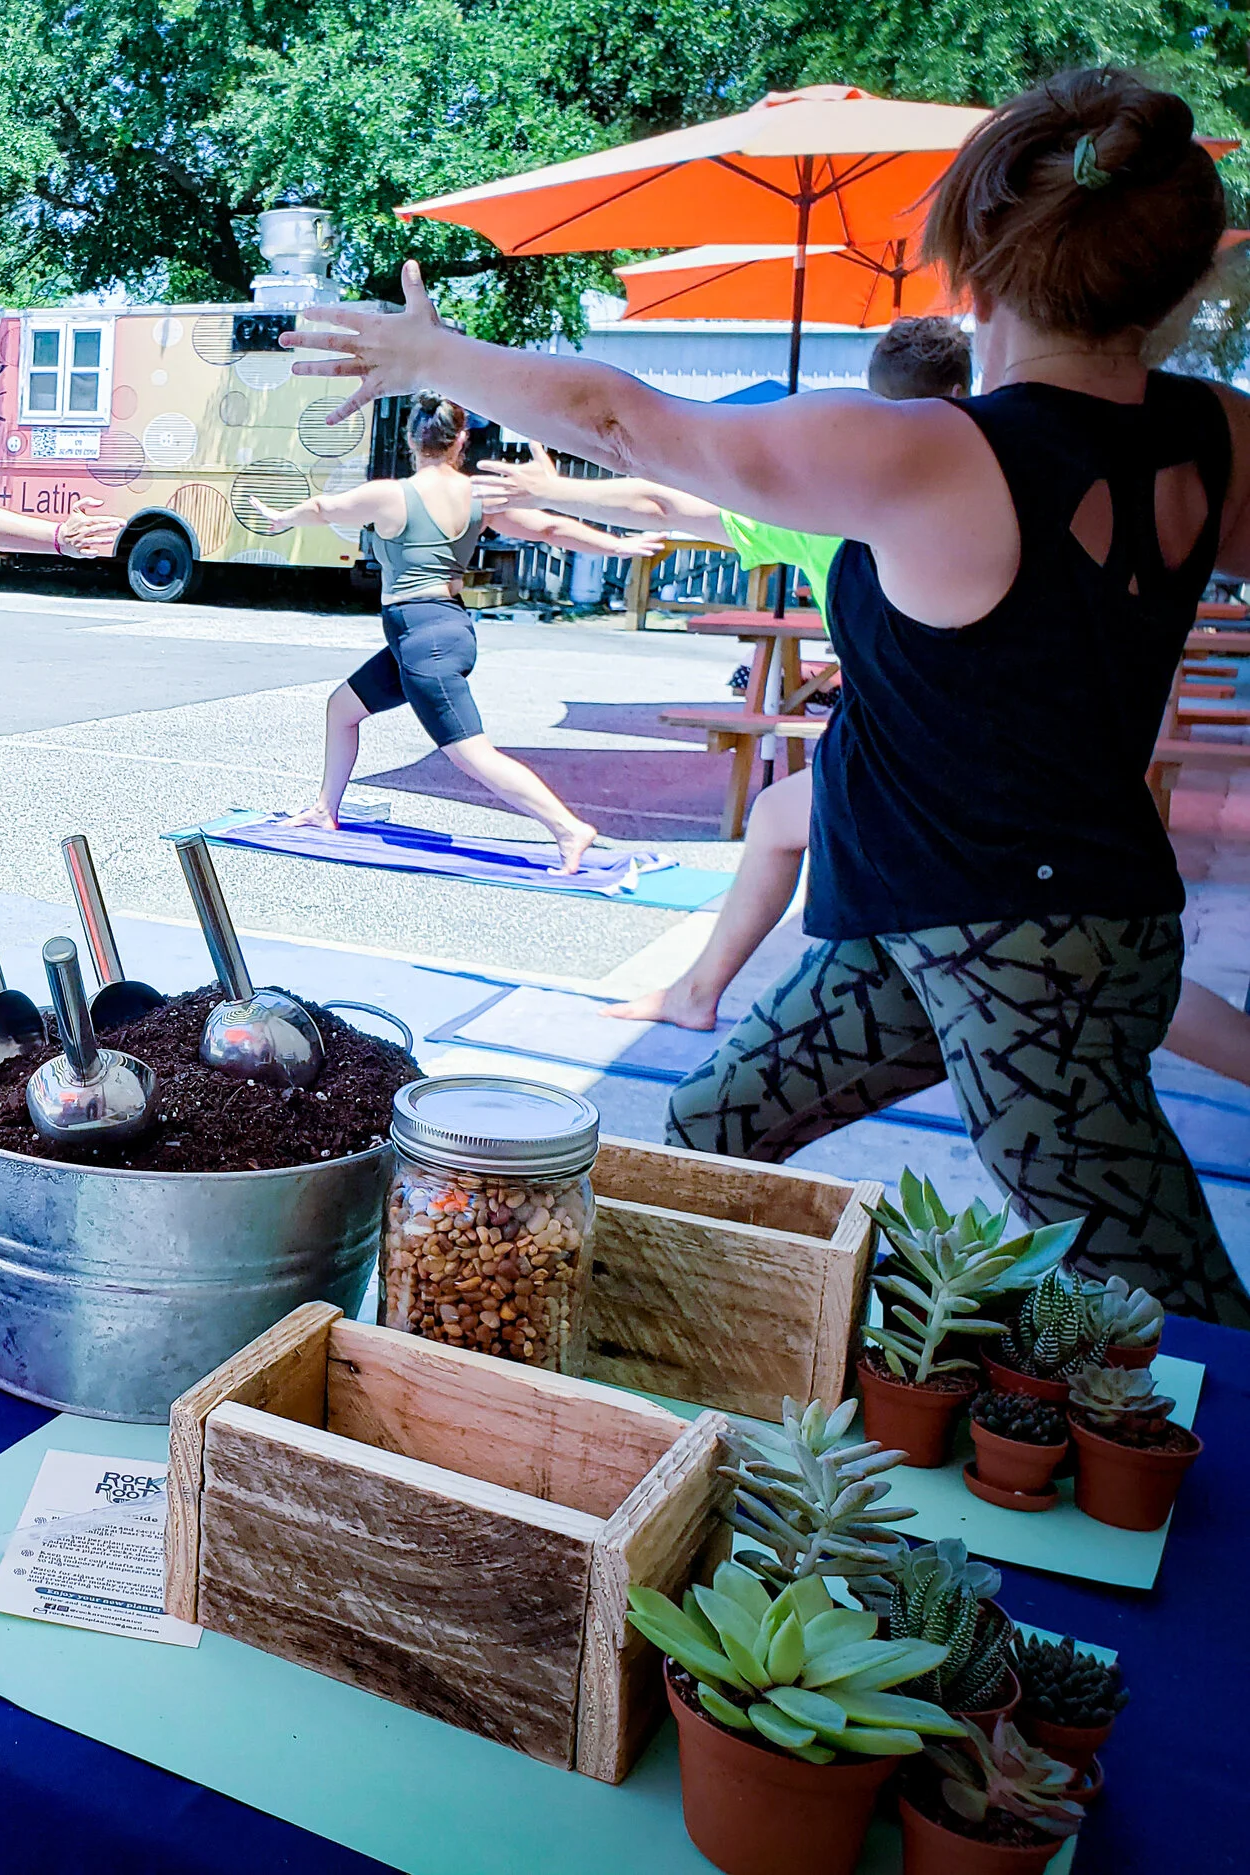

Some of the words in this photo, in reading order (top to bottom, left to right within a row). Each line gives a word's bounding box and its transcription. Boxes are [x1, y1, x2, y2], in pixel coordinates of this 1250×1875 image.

[21, 481, 81, 515] Latin
[95, 1483, 161, 1502] ROOT
[49, 1539, 91, 1549] nderneath
[123, 1554, 156, 1563] dropper
[105, 1565, 161, 1578] temperatures
[28, 1573, 91, 1588] underwatering
[93, 1584, 121, 1592] where
[122, 1589, 148, 1597] leaves
[88, 1579, 117, 1588] mushy
[130, 1586, 158, 1595] yellow
[106, 1578, 163, 1591] overwatering
[46, 1588, 75, 1598] Enjoy
[76, 1594, 101, 1603] your
[102, 1598, 124, 1606] new
[126, 1602, 161, 1613] plants!
